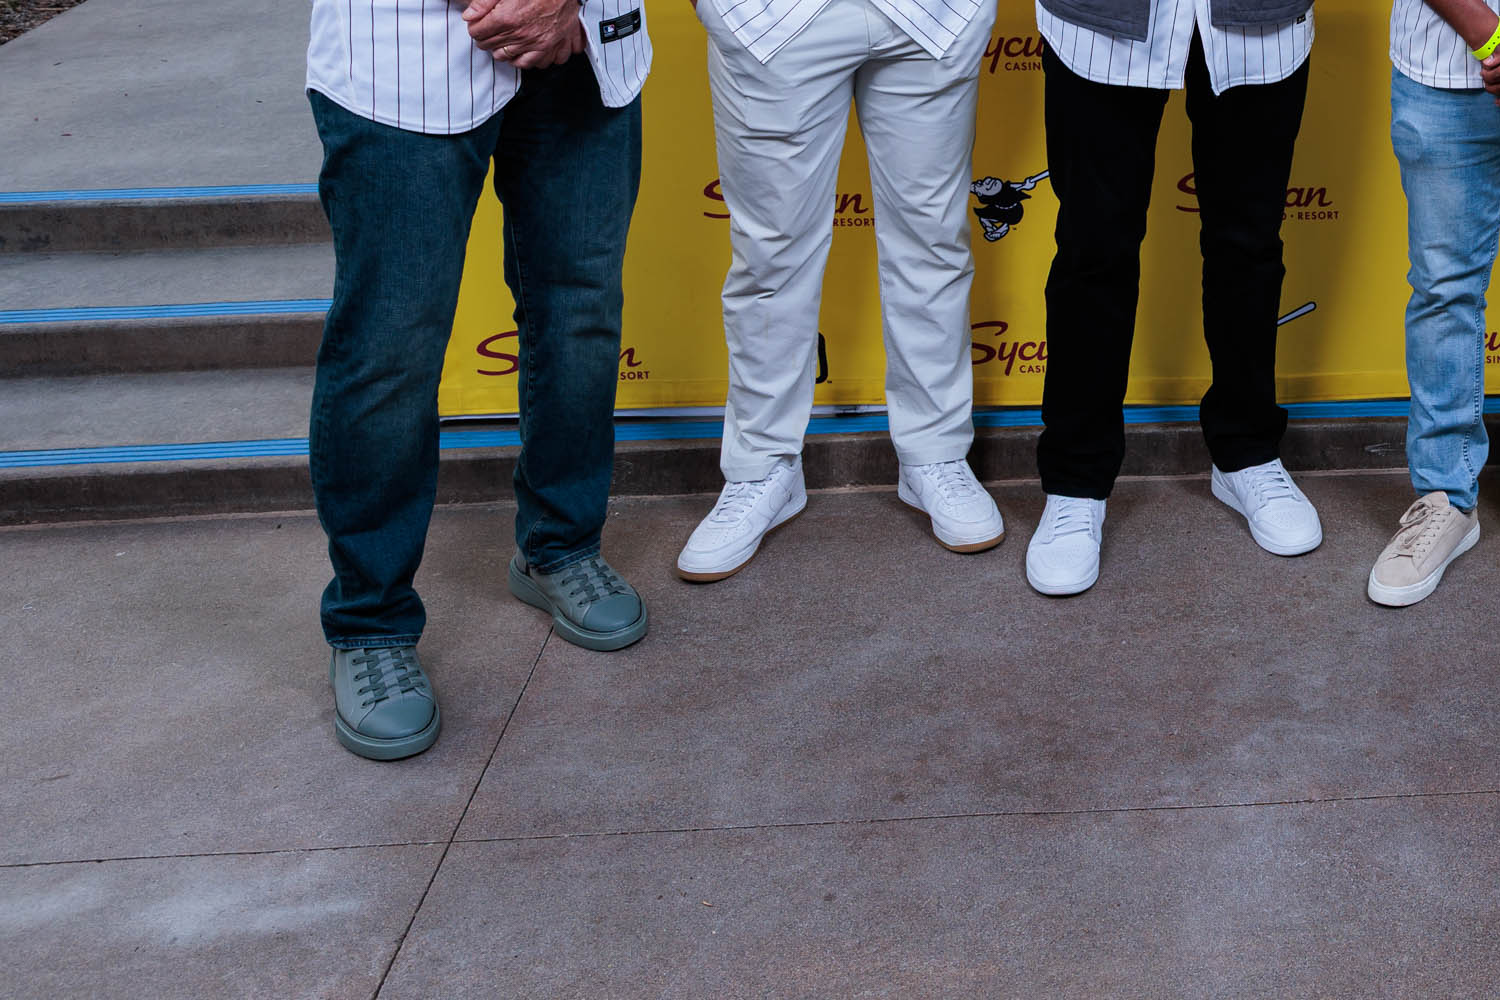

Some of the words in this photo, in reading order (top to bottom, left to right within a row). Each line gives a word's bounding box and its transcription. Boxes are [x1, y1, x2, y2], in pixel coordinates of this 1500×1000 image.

[1005, 62, 1040, 71] CASIN
[1297, 211, 1339, 220] RESORT
[1019, 365, 1045, 373] CASI
